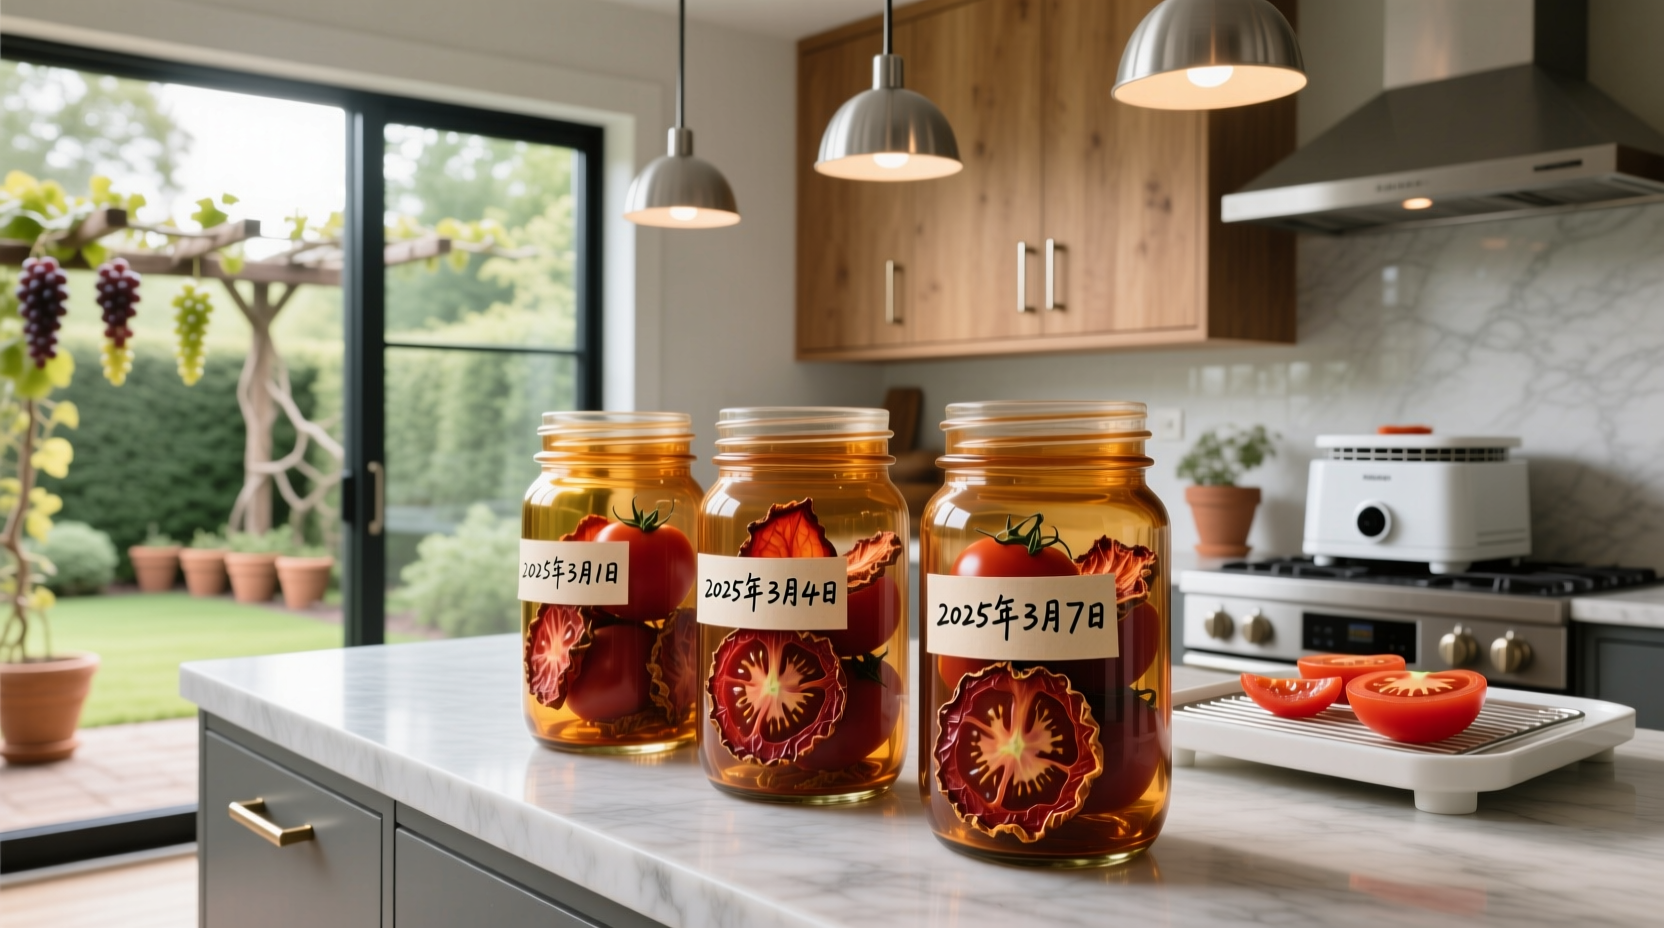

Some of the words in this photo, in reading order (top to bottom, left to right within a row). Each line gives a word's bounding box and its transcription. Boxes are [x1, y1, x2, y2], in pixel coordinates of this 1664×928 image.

[522, 556, 618, 590] 2025年3月1日
[704, 572, 837, 613] 2025年3月4日
[936, 594, 1104, 642] 2025年3月7日
